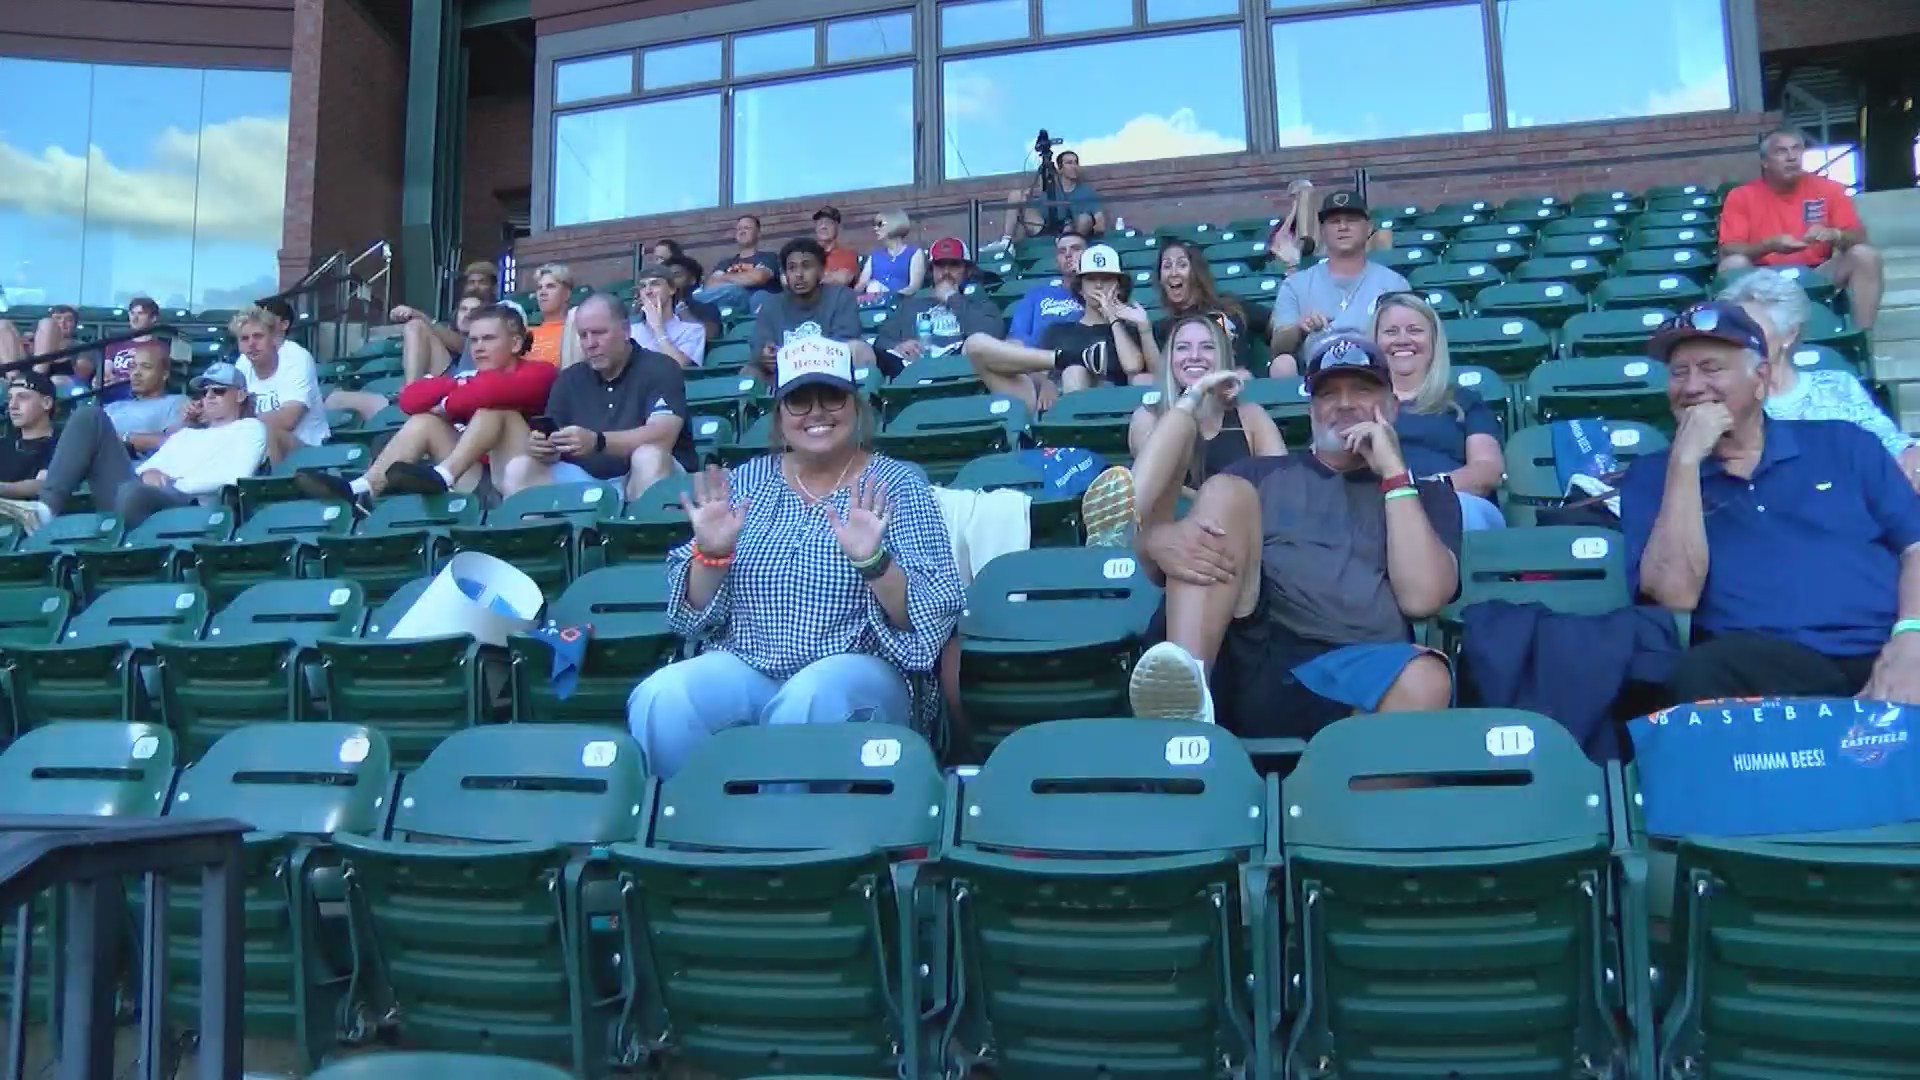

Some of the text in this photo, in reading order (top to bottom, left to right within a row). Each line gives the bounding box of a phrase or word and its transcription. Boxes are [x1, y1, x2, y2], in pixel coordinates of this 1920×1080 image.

[1111, 561, 1129, 576] 10
[1500, 731, 1520, 751] 11
[1841, 731, 1907, 749] EASTFIELD
[876, 743, 888, 760] 9
[1179, 740, 1201, 761] 10
[1733, 752, 1789, 772] HUMMM
[1790, 748, 1826, 769] BEES!
